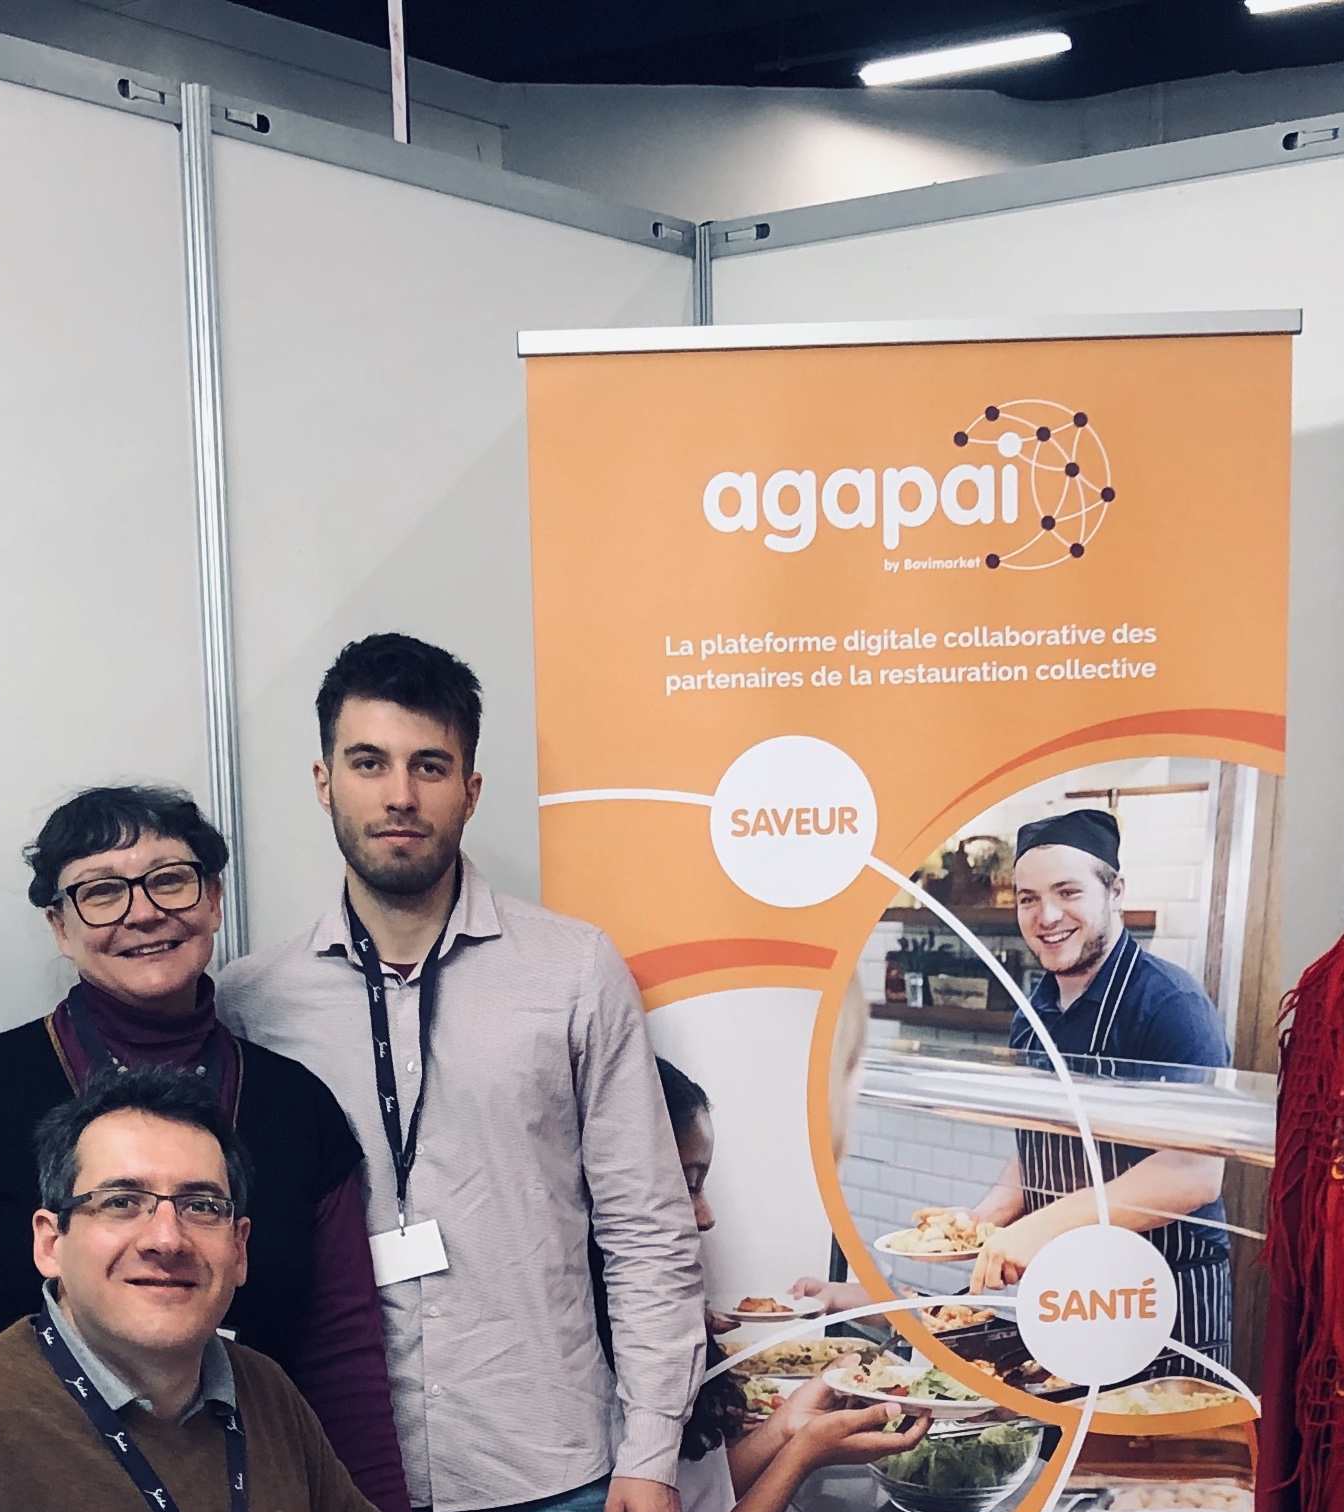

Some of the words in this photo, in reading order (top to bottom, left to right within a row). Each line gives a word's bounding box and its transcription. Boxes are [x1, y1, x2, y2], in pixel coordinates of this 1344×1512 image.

[703, 431, 1019, 552] agapai
[884, 559, 900, 573] by
[904, 556, 981, 571] Bovimarket
[665, 636, 694, 656] La
[701, 631, 837, 661] plateforme
[843, 627, 938, 656] digitale
[943, 624, 1106, 648] collaborative
[1112, 622, 1157, 644] des
[665, 667, 804, 696] partenaires
[811, 665, 842, 687] de
[849, 664, 872, 686] la
[879, 660, 1028, 685] restauration
[1035, 657, 1157, 681] collective
[731, 806, 858, 838] SAVEUR
[1038, 1278, 1157, 1323] SANTÉ
